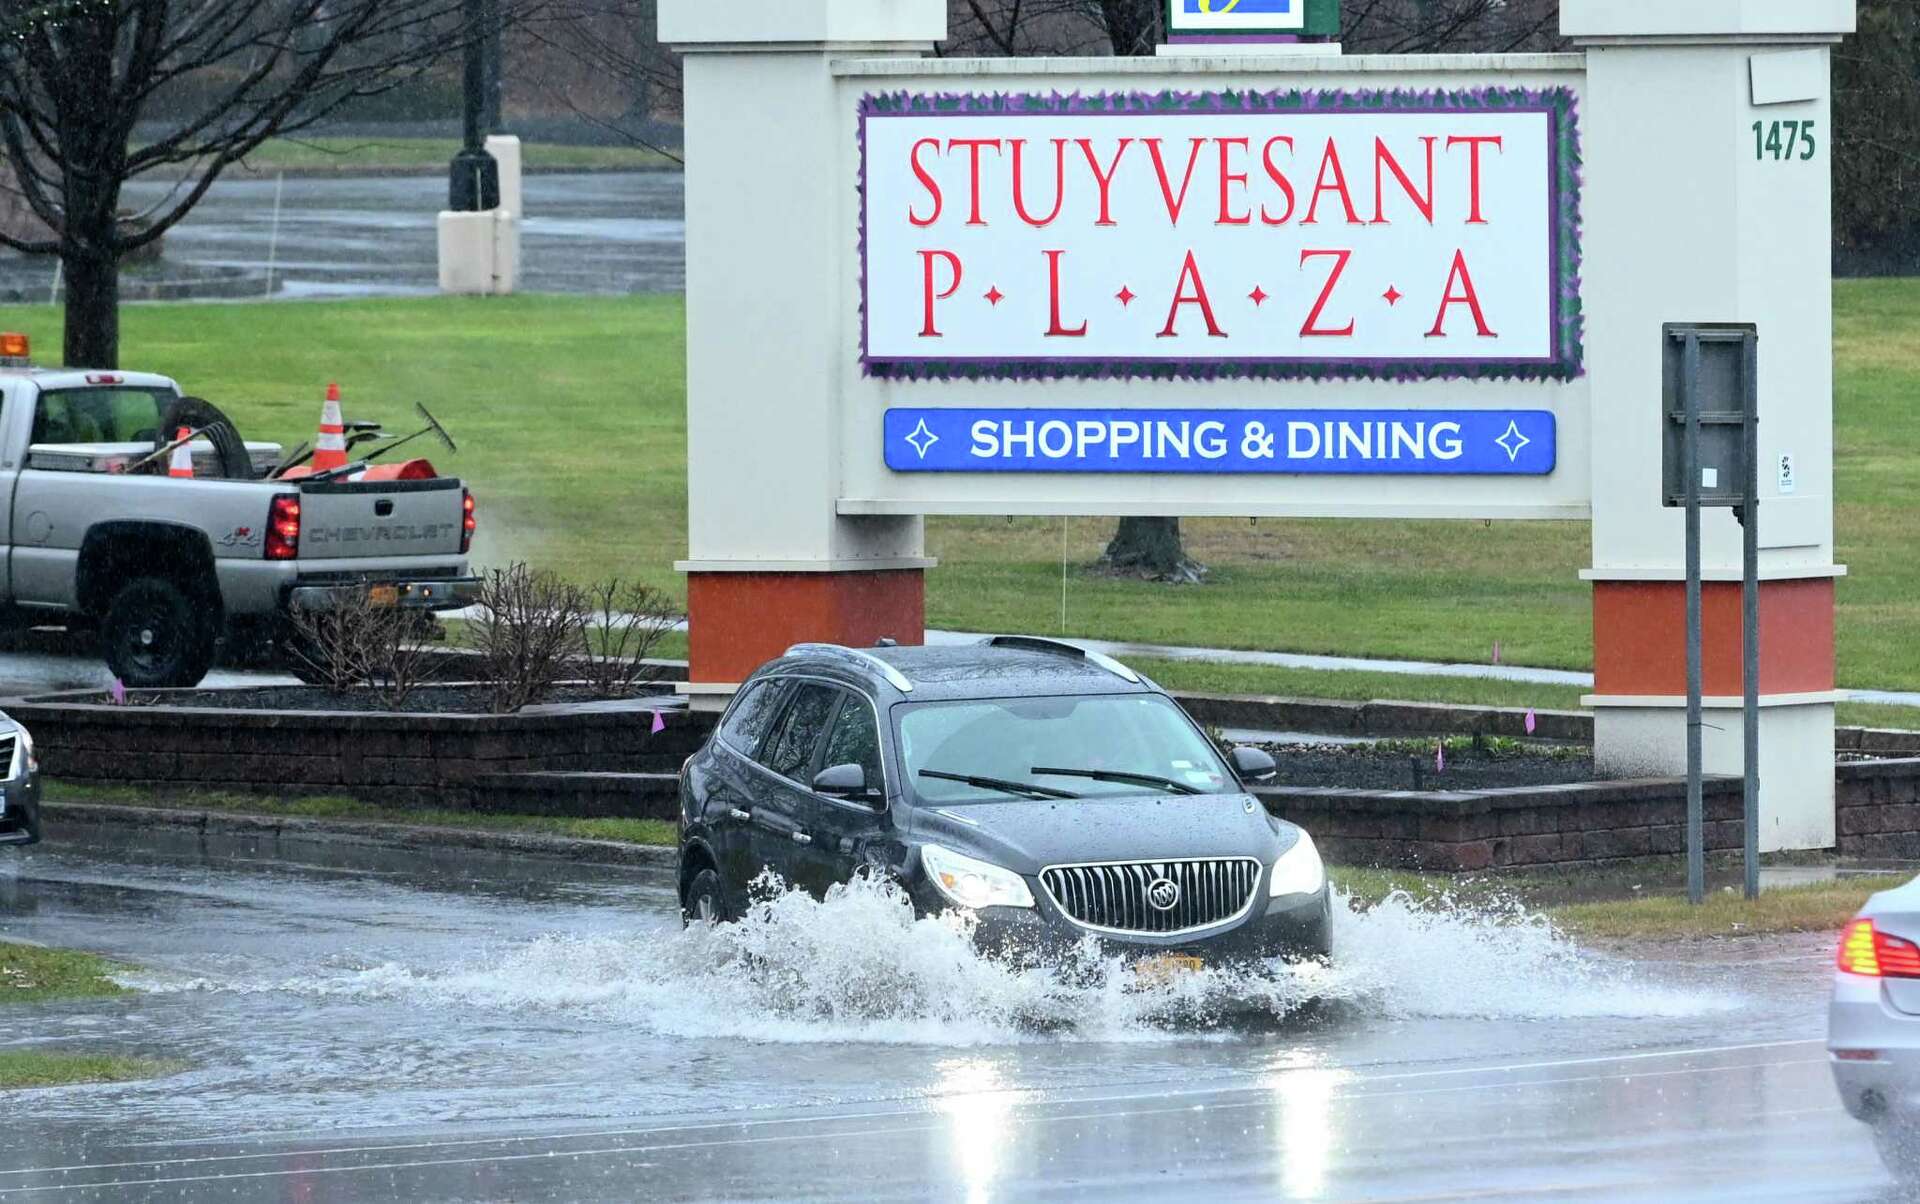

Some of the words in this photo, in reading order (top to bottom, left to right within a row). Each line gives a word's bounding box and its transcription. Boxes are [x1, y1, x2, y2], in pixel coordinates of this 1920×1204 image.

[1752, 120, 1816, 161] 1475
[908, 135, 1502, 227] STUYVESANT
[970, 419, 1228, 459] SHOPPING
[1240, 421, 1274, 459] &
[1287, 421, 1463, 460] DINING
[308, 524, 454, 543] CHEVROLET
